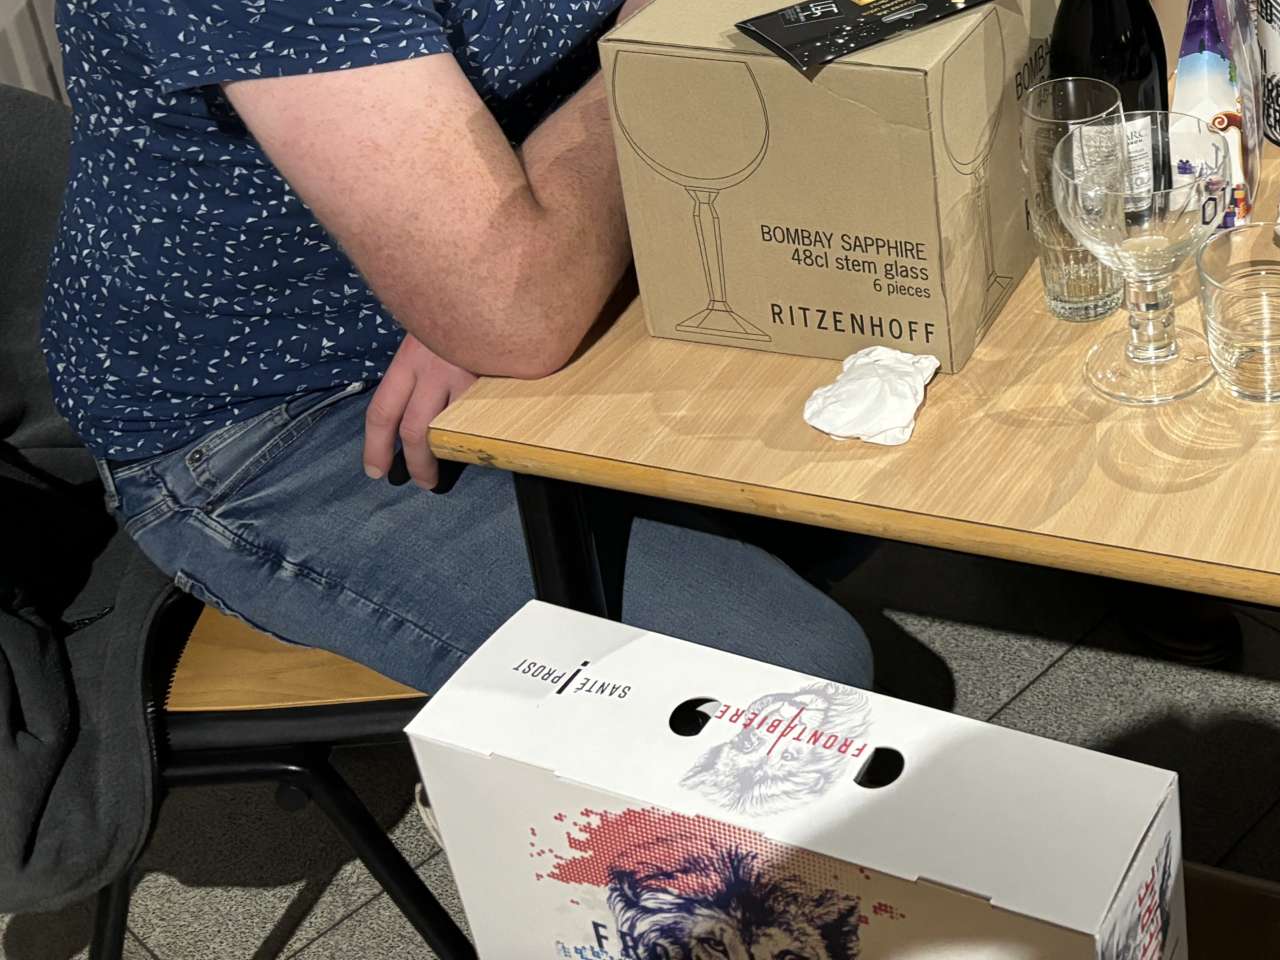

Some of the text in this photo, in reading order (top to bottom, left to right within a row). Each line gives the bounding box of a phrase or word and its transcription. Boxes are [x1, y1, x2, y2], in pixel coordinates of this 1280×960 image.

[760, 224, 928, 260] BOMBAY SAPPHIRE
[791, 248, 930, 282] 48cl stem glass
[873, 278, 932, 300] 6 pieces
[770, 303, 936, 344] RITZENHOFF
[512, 658, 567, 684] PROST
